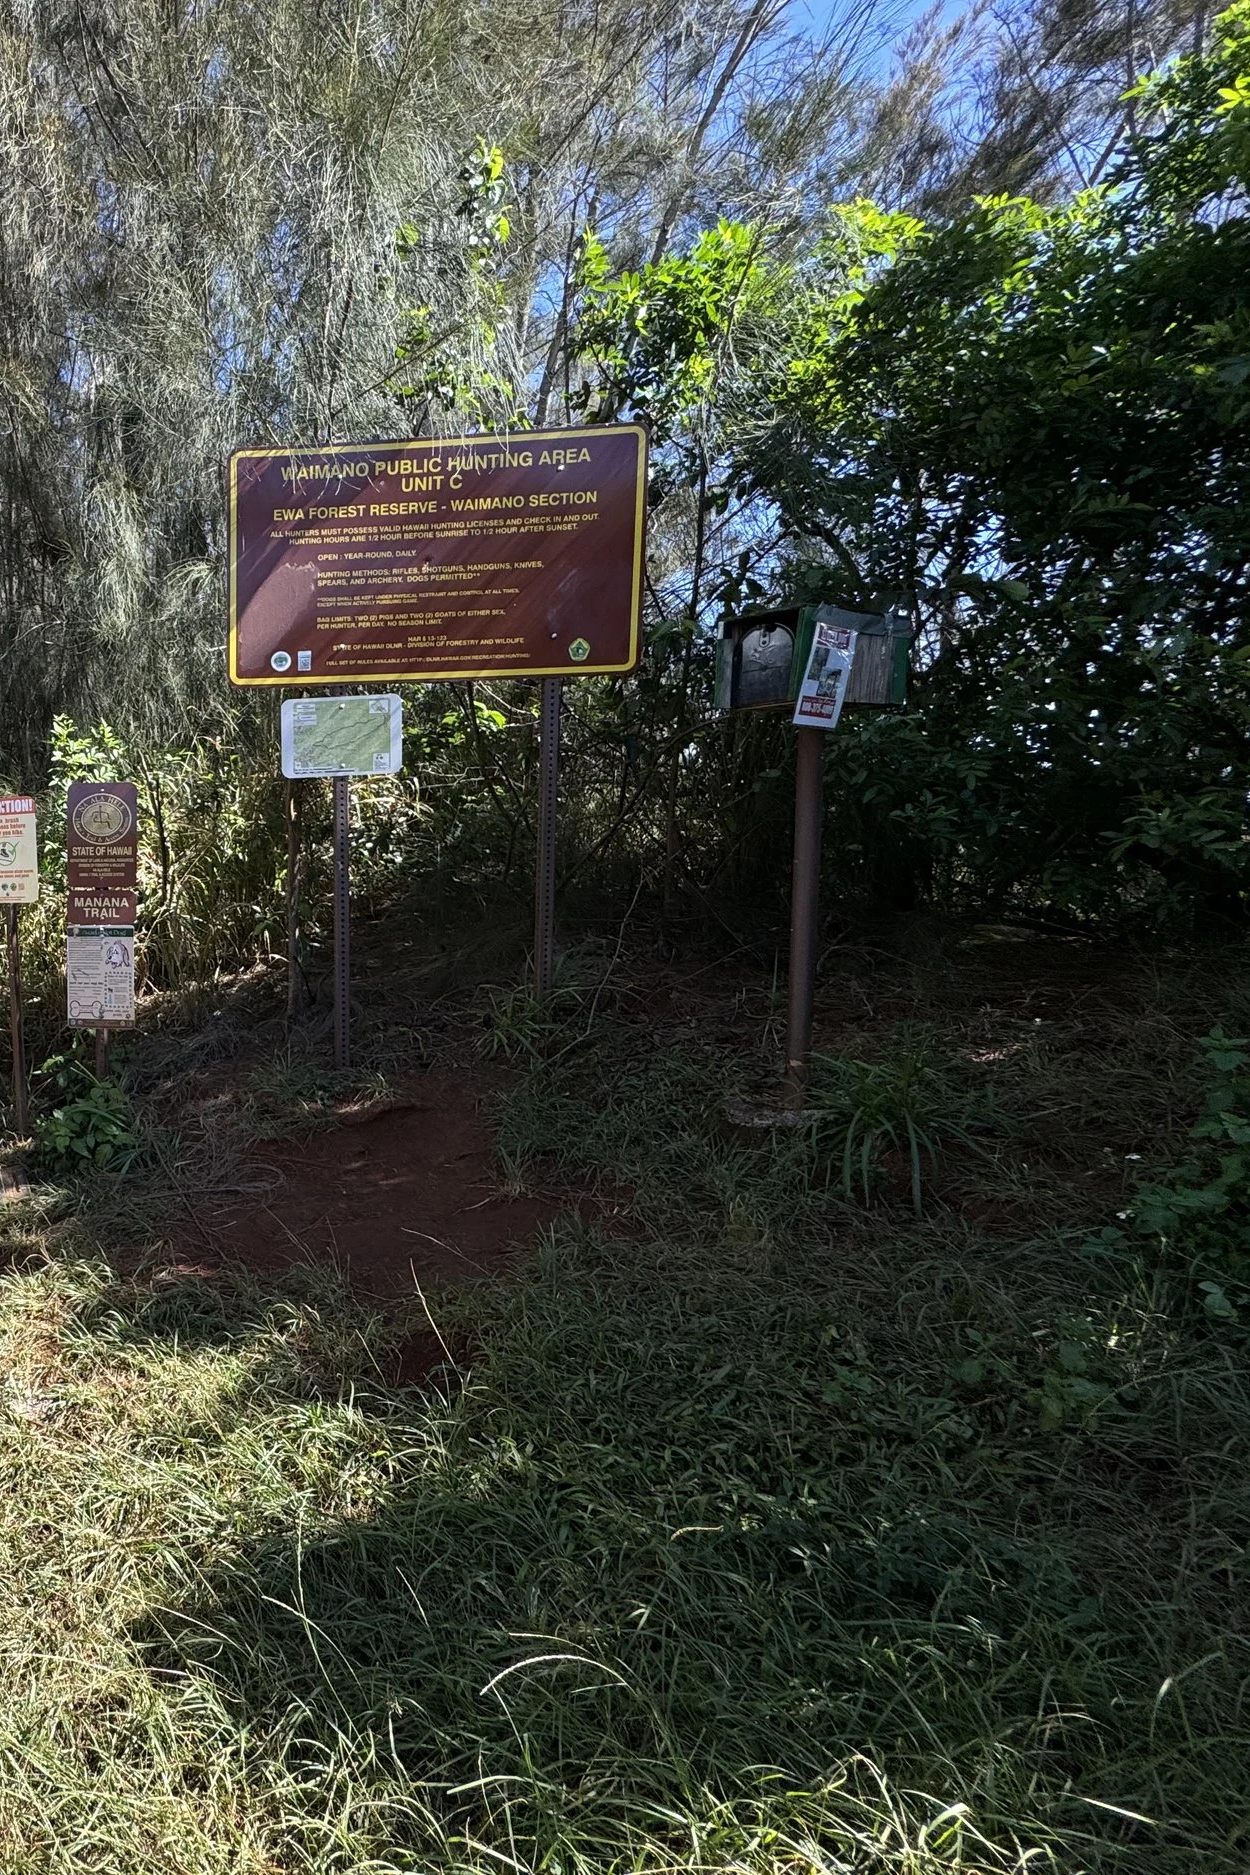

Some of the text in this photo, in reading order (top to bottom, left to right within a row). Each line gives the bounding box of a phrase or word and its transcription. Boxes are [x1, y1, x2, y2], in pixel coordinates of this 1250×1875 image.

[281, 448, 591, 481] WAIMANO PUBLIC HUNTING AREA
[402, 475, 463, 492] UNIT C
[273, 508, 305, 521] EWA
[309, 505, 366, 519] FOREST
[370, 501, 437, 516] RESERVE
[451, 496, 524, 512] WAIMANO
[529, 491, 597, 507] SECTION
[321, 528, 342, 536] MUST
[343, 526, 378, 535] POSSESS
[380, 525, 400, 533] VALID
[402, 524, 429, 532] HAWAII
[431, 522, 465, 530] HUNTING
[466, 520, 504, 528] LICENSES
[506, 518, 523, 526] AND
[524, 516, 551, 524] CHECK
[582, 513, 599, 521] OUT.
[324, 536, 350, 544] HOURS
[369, 534, 378, 542] 1/2
[380, 533, 402, 541] HOUR
[436, 530, 468, 538] SUNRISE
[470, 528, 481, 536] TO
[496, 526, 518, 534] HOUR
[519, 525, 544, 533] AFTER
[546, 523, 578, 531] SUNSET.
[344, 551, 394, 560] YEAR-ROUND,
[318, 571, 350, 579] HUNTING
[352, 569, 391, 577] METHODS:
[393, 567, 420, 575] RIFLES,
[422, 565, 466, 574] SHOTGUNS,
[468, 562, 512, 571] HANDGUNS,
[72, 846, 133, 856] STATE OF HAWAII
[74, 898, 129, 908] MANANA
[83, 908, 120, 918] TRAIL
